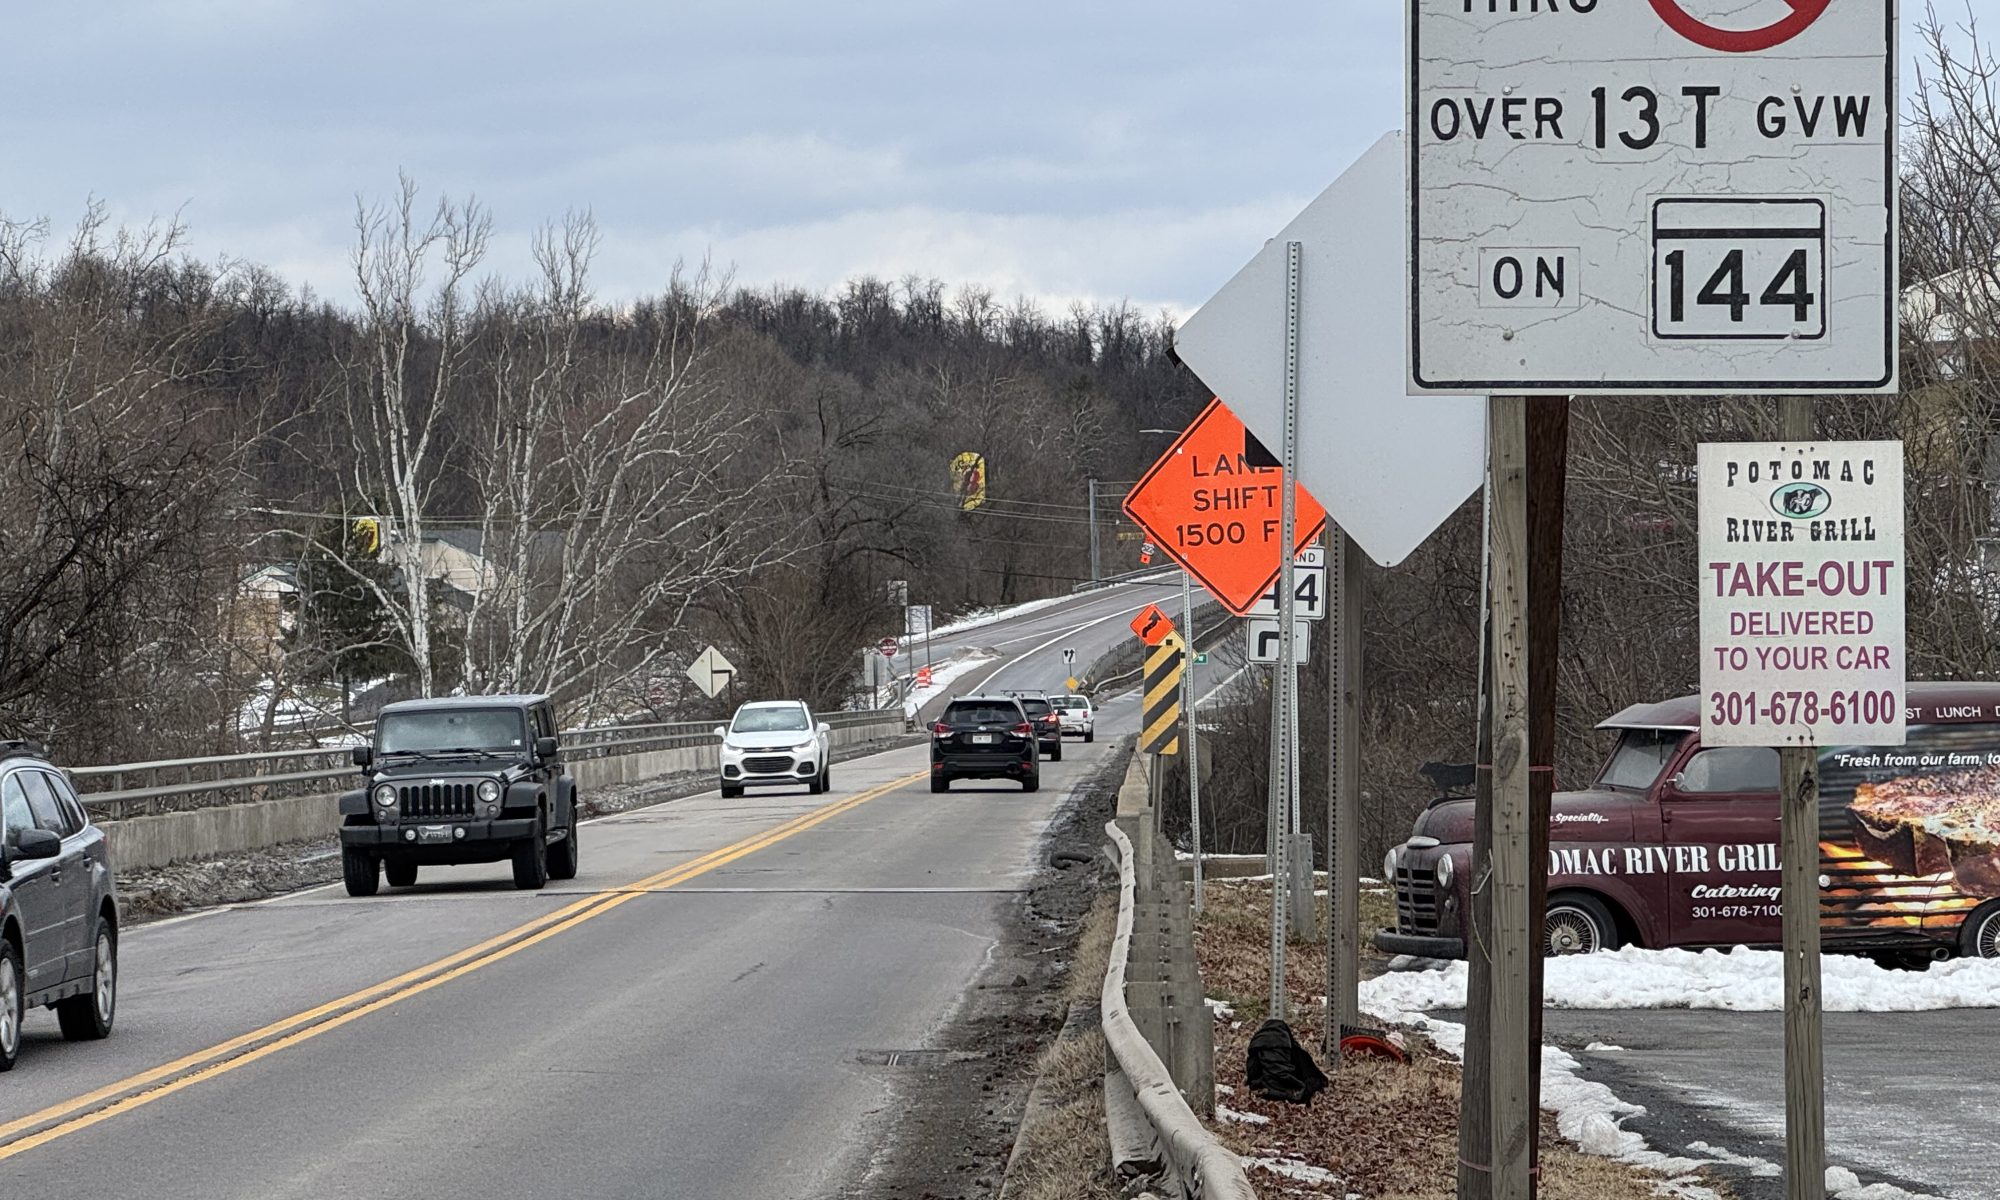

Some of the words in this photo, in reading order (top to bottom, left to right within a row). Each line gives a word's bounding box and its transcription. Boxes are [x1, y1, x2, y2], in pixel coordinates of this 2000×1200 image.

[1430, 98, 1564, 140] OVER
[1591, 86, 1660, 150] 13
[1682, 86, 1720, 149] T
[1757, 95, 1871, 139] GVW
[1493, 256, 1564, 299] ON
[1664, 249, 1815, 322] 144
[1192, 453, 1275, 478] LAN
[1727, 460, 1875, 488] POTOMAC
[1193, 486, 1278, 511] SHIFT
[1176, 521, 1246, 548] 1500
[1726, 517, 1795, 543] RIVER
[1810, 516, 1876, 542] GRILL
[1709, 560, 1895, 598] TAKE-OUT
[1730, 611, 1874, 636] DELIVERED
[1714, 647, 1748, 671] TO
[1755, 646, 1828, 671] YOUR
[1836, 646, 1891, 670] CAR
[1711, 690, 1896, 726] 301-678-6100
[1935, 706, 1982, 719] LUNCH
[1833, 754, 1880, 768] "Fresh
[1884, 753, 1917, 767] from
[1920, 754, 1946, 767] our
[1948, 752, 1983, 767] farm,
[1623, 845, 1710, 875] RIVER
[1691, 884, 1782, 900] Catering
